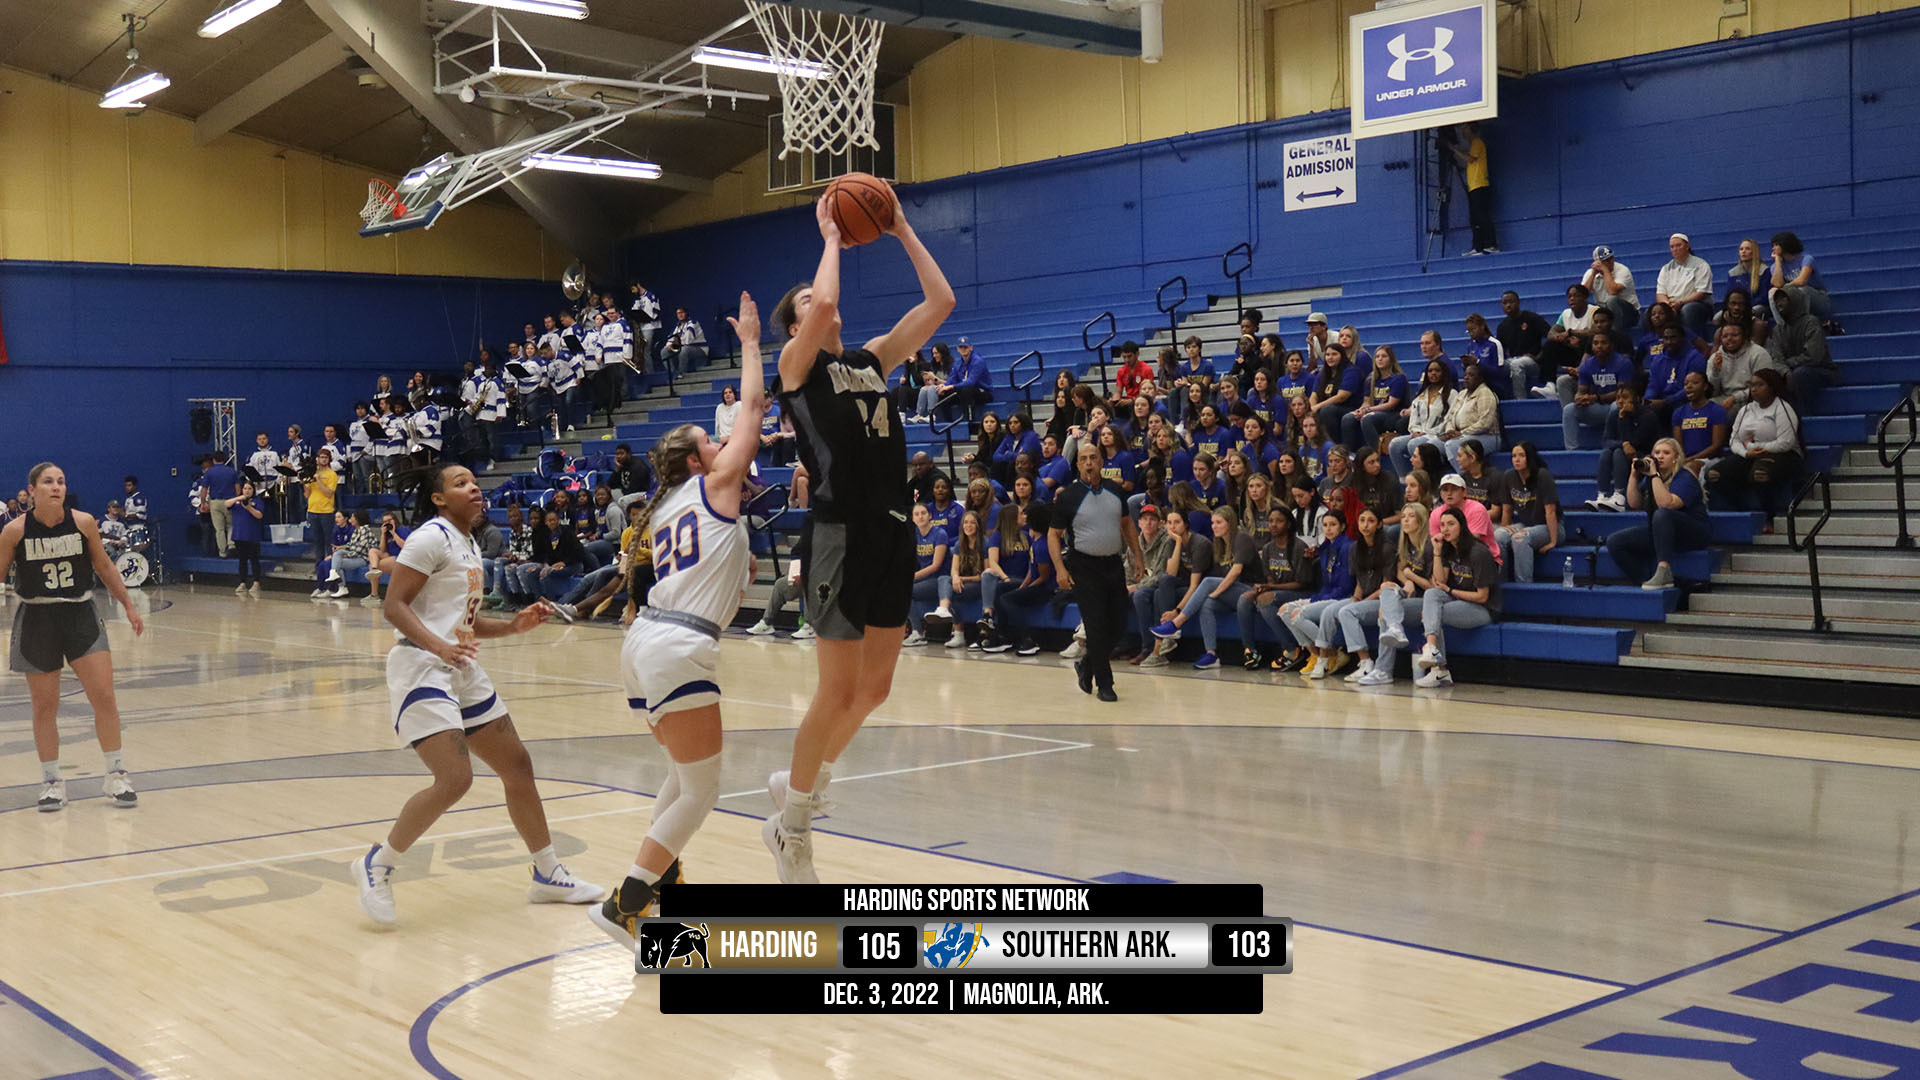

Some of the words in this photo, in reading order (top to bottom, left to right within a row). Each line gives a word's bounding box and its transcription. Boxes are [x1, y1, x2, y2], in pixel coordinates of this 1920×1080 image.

[1376, 88, 1415, 102] UNDER
[1416, 79, 1466, 95] ARMOUR
[1289, 137, 1352, 160] GENERAL
[1286, 156, 1354, 179] ADMISSION
[654, 510, 701, 581] 20
[42, 561, 74, 590] 32
